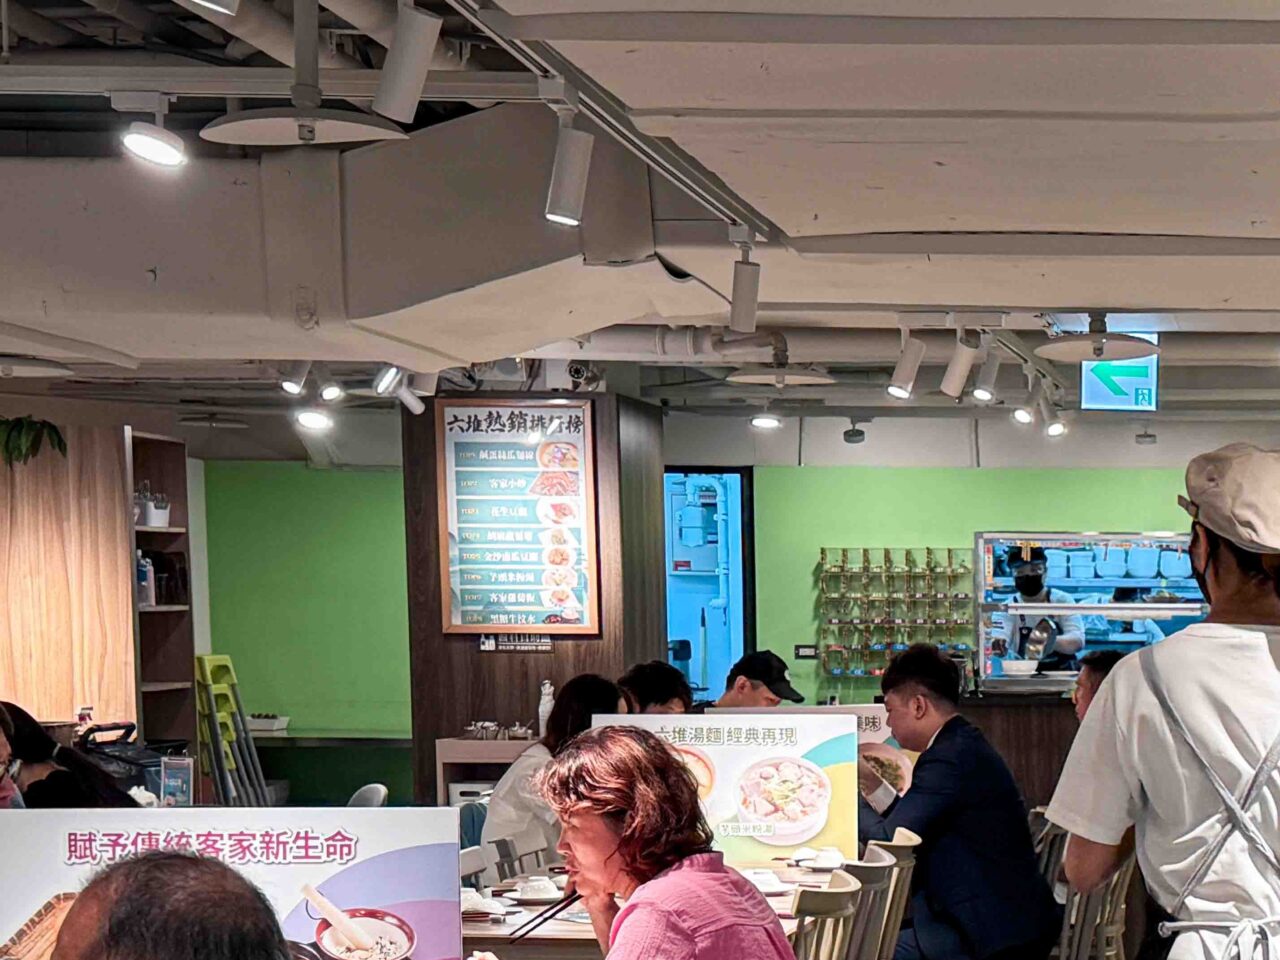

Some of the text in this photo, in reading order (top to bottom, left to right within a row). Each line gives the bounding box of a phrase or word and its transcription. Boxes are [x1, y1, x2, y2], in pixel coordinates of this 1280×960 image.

[447, 410, 583, 434] 六堆熱銷排行榜
[654, 726, 796, 745] 六堆湯麵 經典再現
[67, 830, 355, 862] 賦予傳統客家新生命
